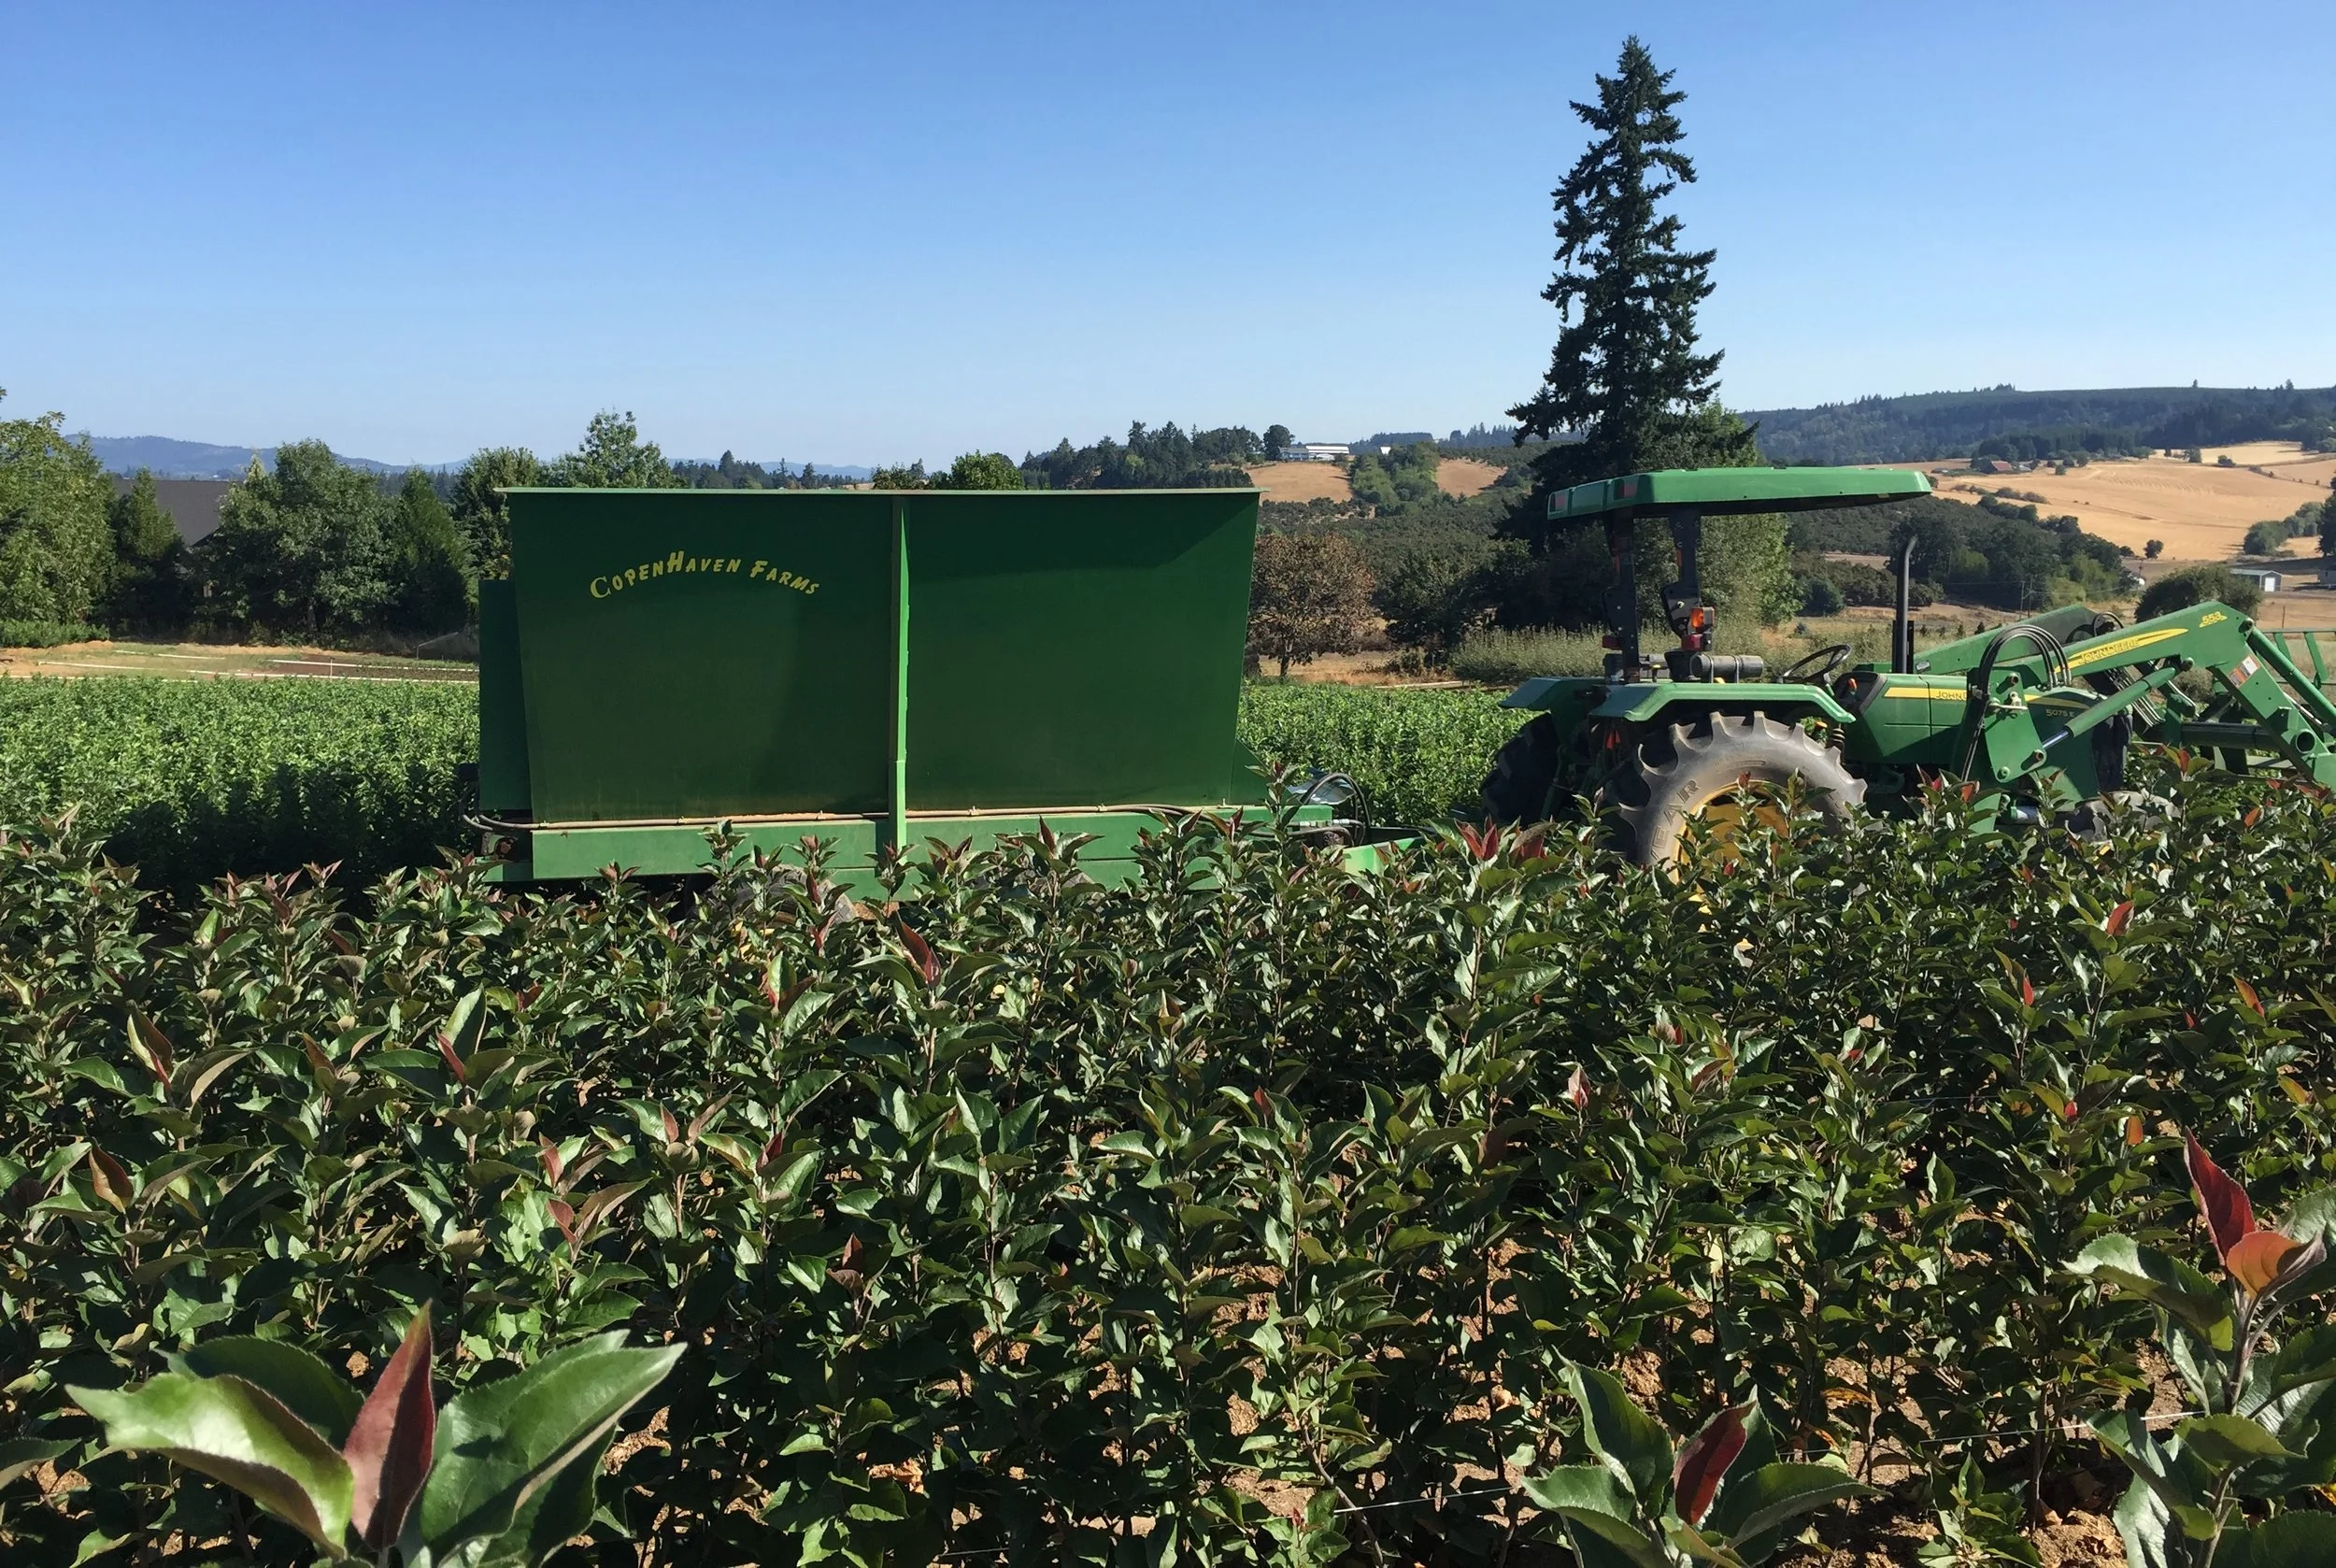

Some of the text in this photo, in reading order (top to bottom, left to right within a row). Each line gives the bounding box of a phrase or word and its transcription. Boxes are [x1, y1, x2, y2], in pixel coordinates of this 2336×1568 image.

[749, 560, 819, 595] FARMS
[2201, 611, 2222, 624] 553
[2078, 649, 2108, 664] JOHN
[1935, 691, 1962, 700] JOHN
